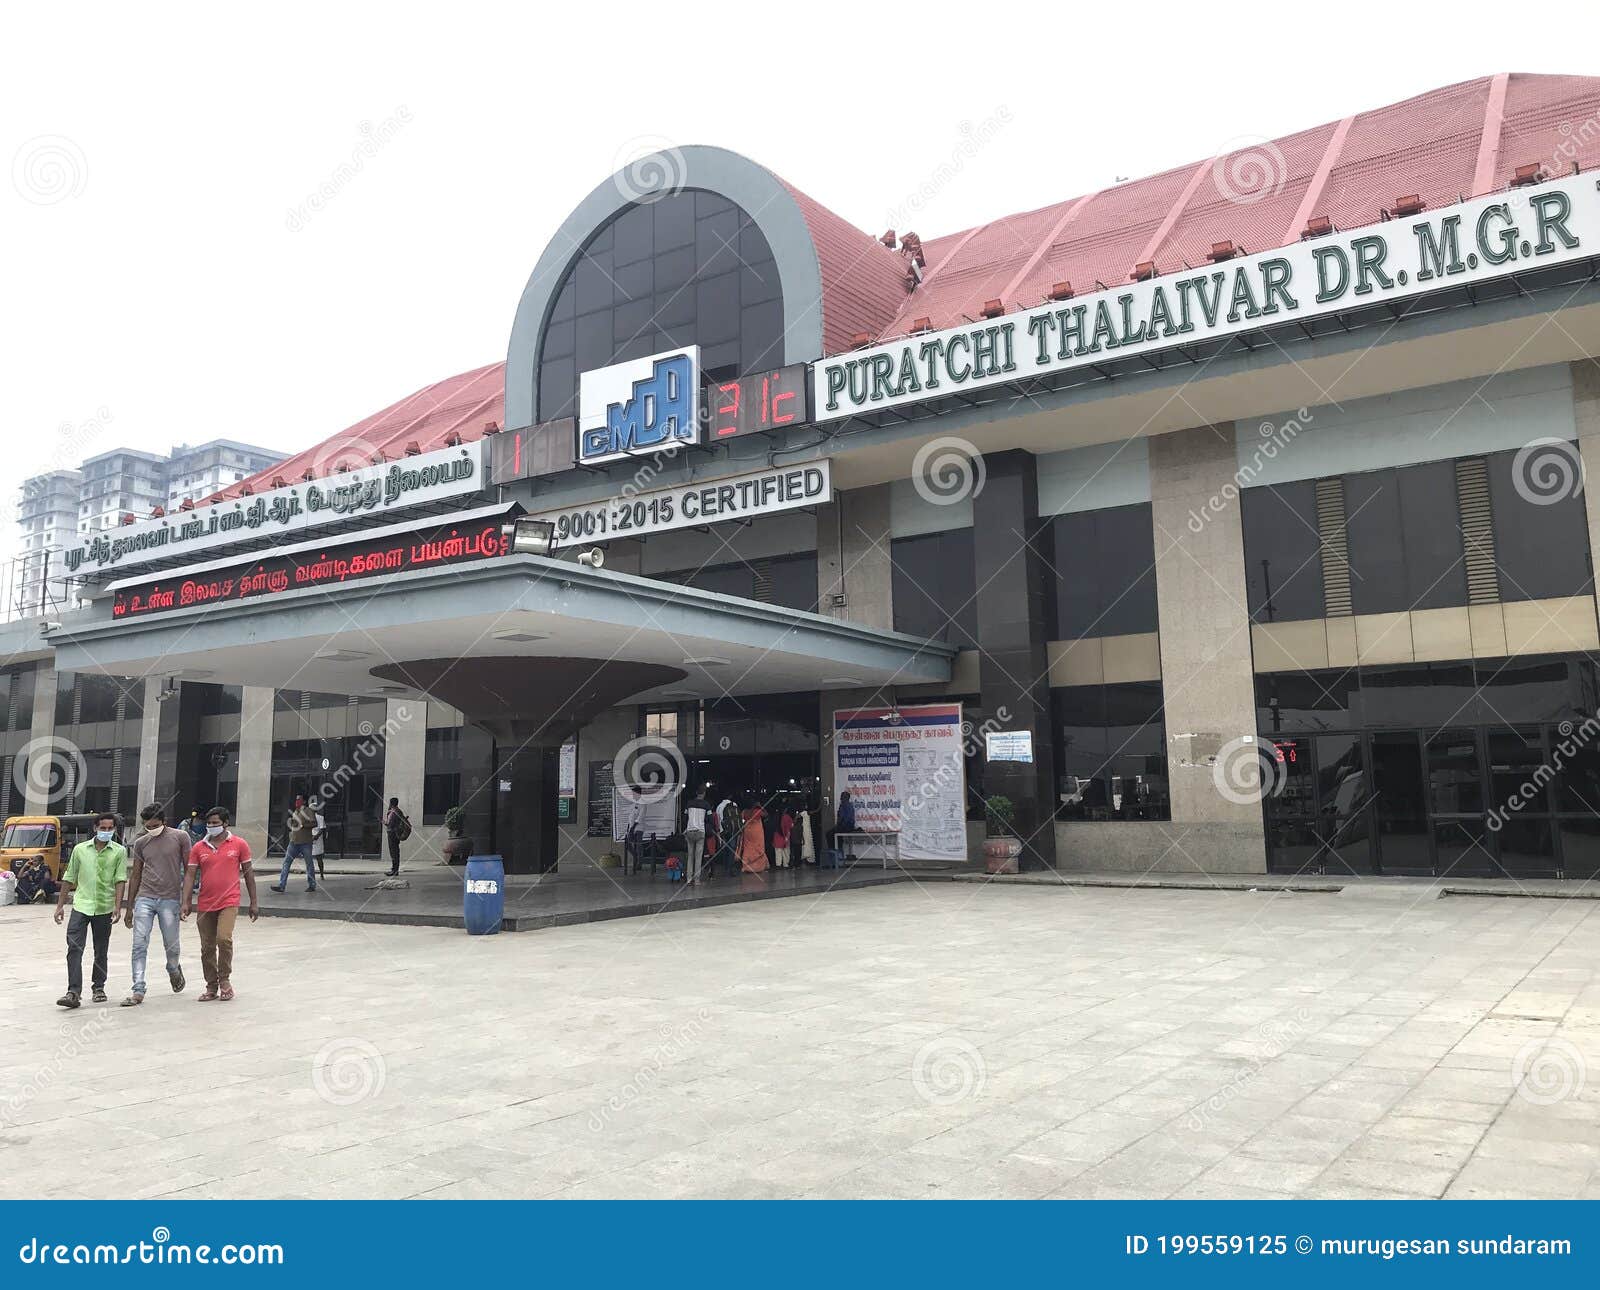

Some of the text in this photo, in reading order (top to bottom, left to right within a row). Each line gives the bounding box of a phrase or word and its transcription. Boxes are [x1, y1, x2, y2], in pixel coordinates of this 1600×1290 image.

[825, 323, 1017, 411] PURATCHI
[1027, 256, 1299, 364] THALAIVAR
[583, 353, 692, 458] CMDA
[64, 534, 111, 571] புரட்சித்
[110, 521, 169, 565] தலைவர்
[169, 508, 218, 544] டாக்டர்
[305, 474, 382, 514] பேருந்து
[384, 449, 474, 505] நிலையம்
[557, 467, 825, 540] 9001:2015 CERTIFIED
[131, 586, 175, 612] உள்ள
[180, 578, 233, 606] இலவச
[239, 566, 288, 599] தள்ளு
[295, 553, 404, 582] வண்டிகளை
